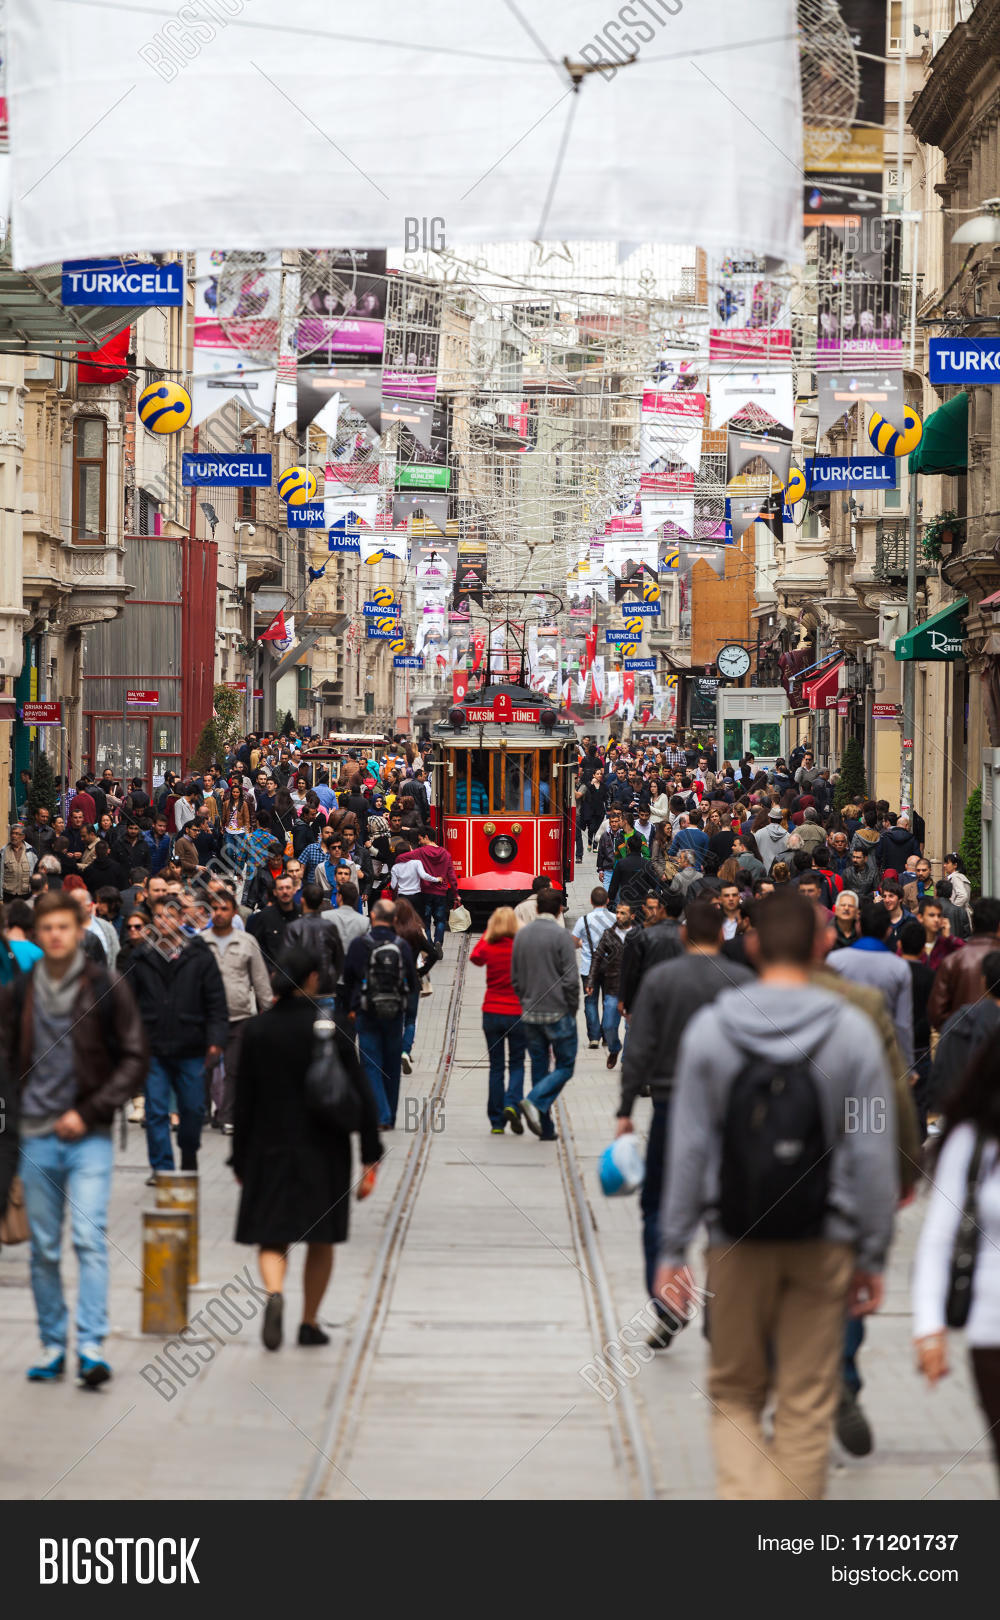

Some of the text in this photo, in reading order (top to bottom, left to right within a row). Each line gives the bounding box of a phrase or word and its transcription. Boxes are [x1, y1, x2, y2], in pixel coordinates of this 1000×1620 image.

[68, 273, 180, 293] TURKCELL
[186, 463, 267, 478] TURKCELL
[809, 465, 891, 481] TURKCELL
[291, 510, 326, 521] TURK
[365, 605, 400, 614] TURKCELL
[624, 605, 659, 613] TURKCELL
[926, 630, 962, 655] Ram
[698, 678, 720, 686] FAUST
[499, 695, 506, 707] 3
[512, 709, 537, 722] TÜNEL
